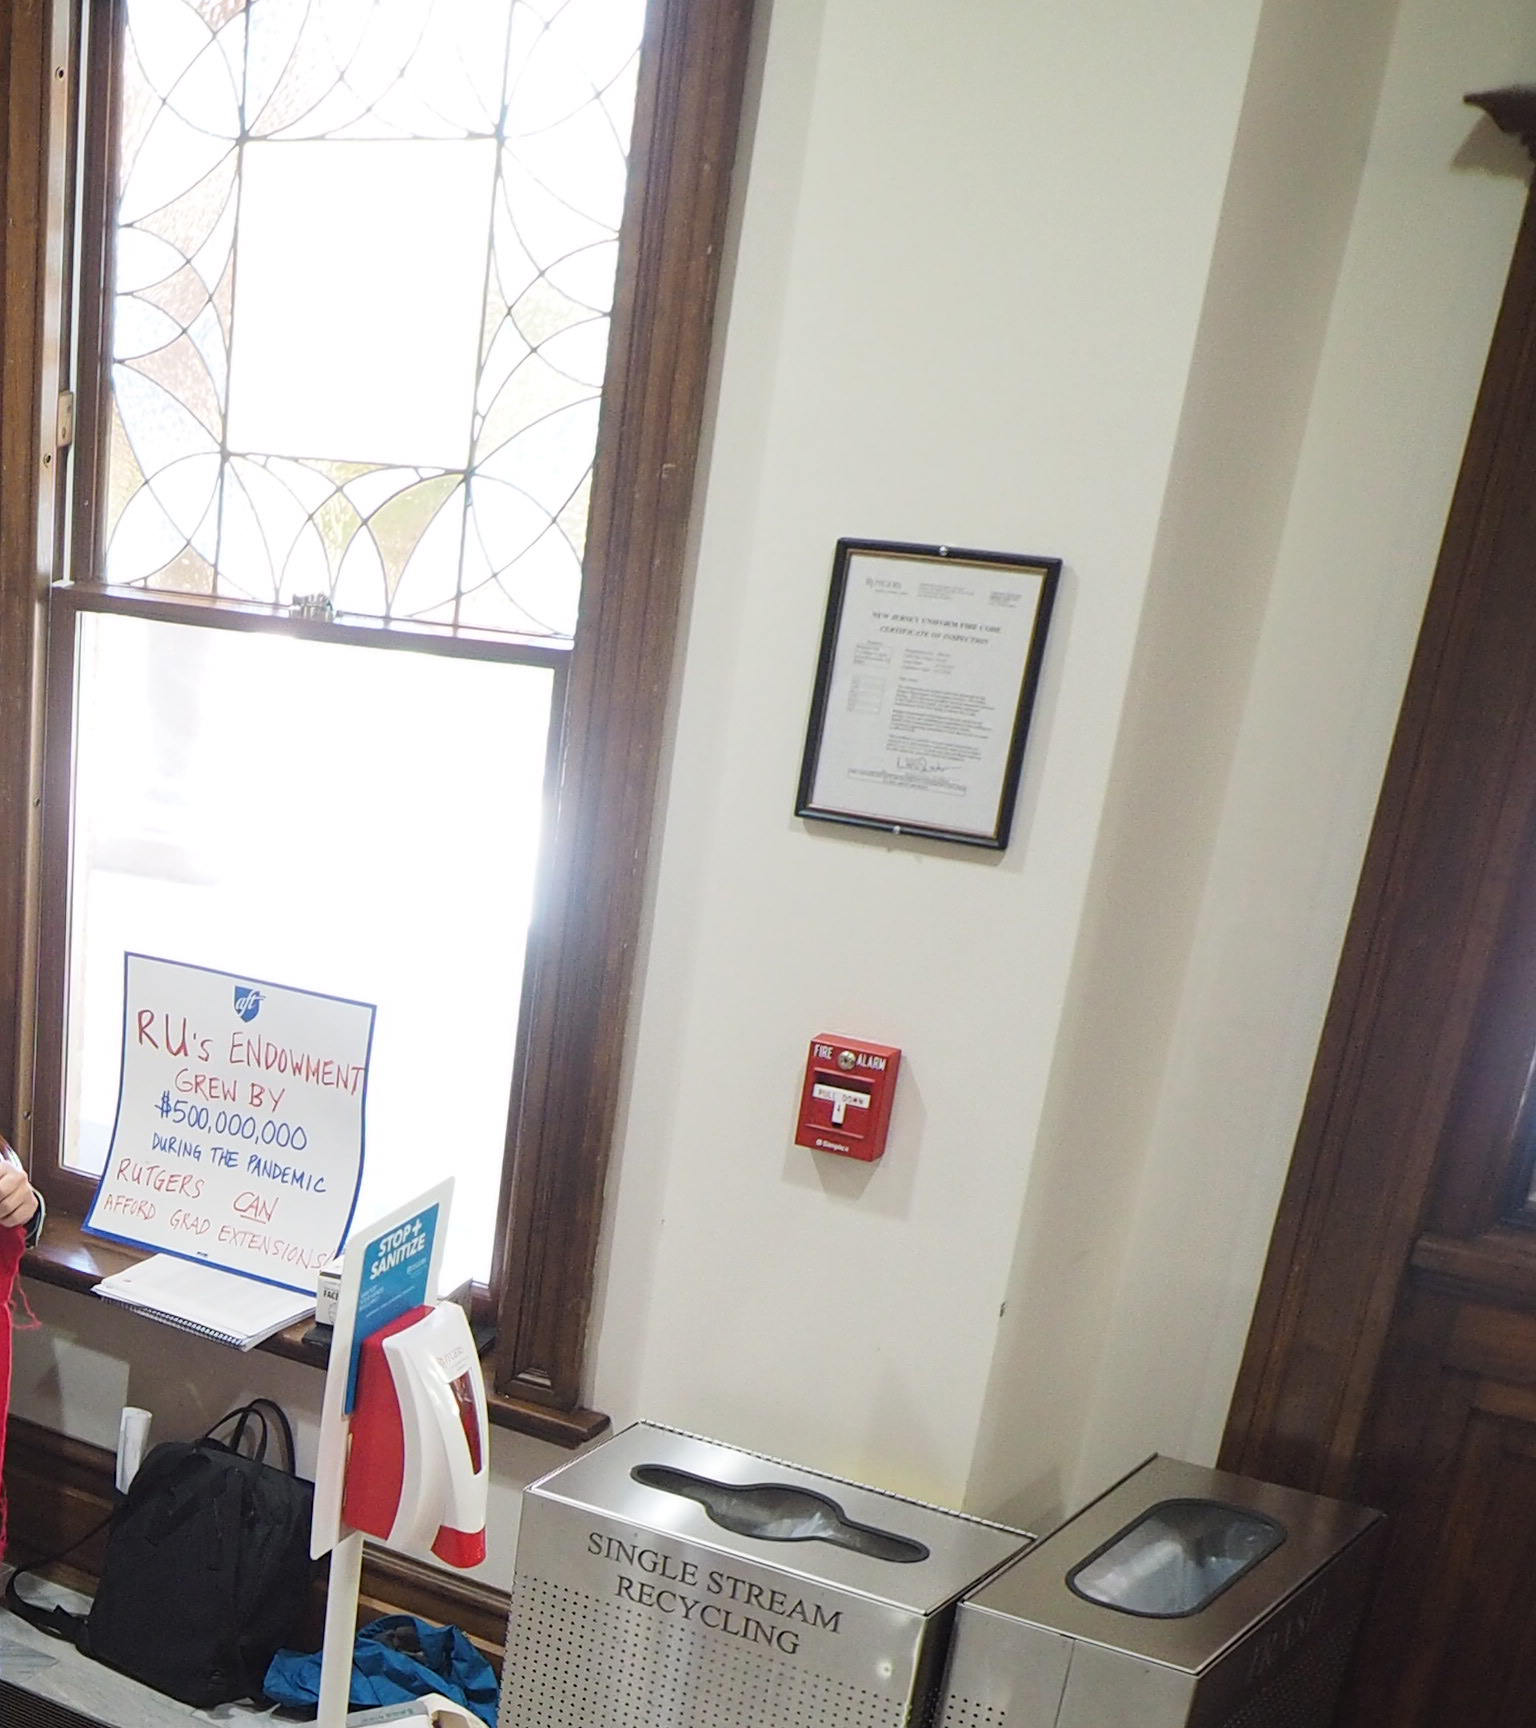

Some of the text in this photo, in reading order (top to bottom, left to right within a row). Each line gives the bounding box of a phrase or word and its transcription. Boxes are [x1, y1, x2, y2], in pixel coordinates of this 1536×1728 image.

[229, 1031, 366, 1096] ENDOWMENT
[814, 1044, 886, 1071] FIRE ALARM
[154, 1090, 308, 1151] $500,000,000
[175, 1068, 285, 1113] GREW BY
[117, 1158, 280, 1223] RUTGERS CAN
[152, 1131, 327, 1194] DURING THE PANDEMIC
[103, 1194, 157, 1221] AFFORD
[169, 1209, 211, 1235] GRAD
[369, 1233, 426, 1281] SANITIZE
[587, 1531, 844, 1635] SINGLE STREAM
[615, 1575, 801, 1655] RECYCLING
